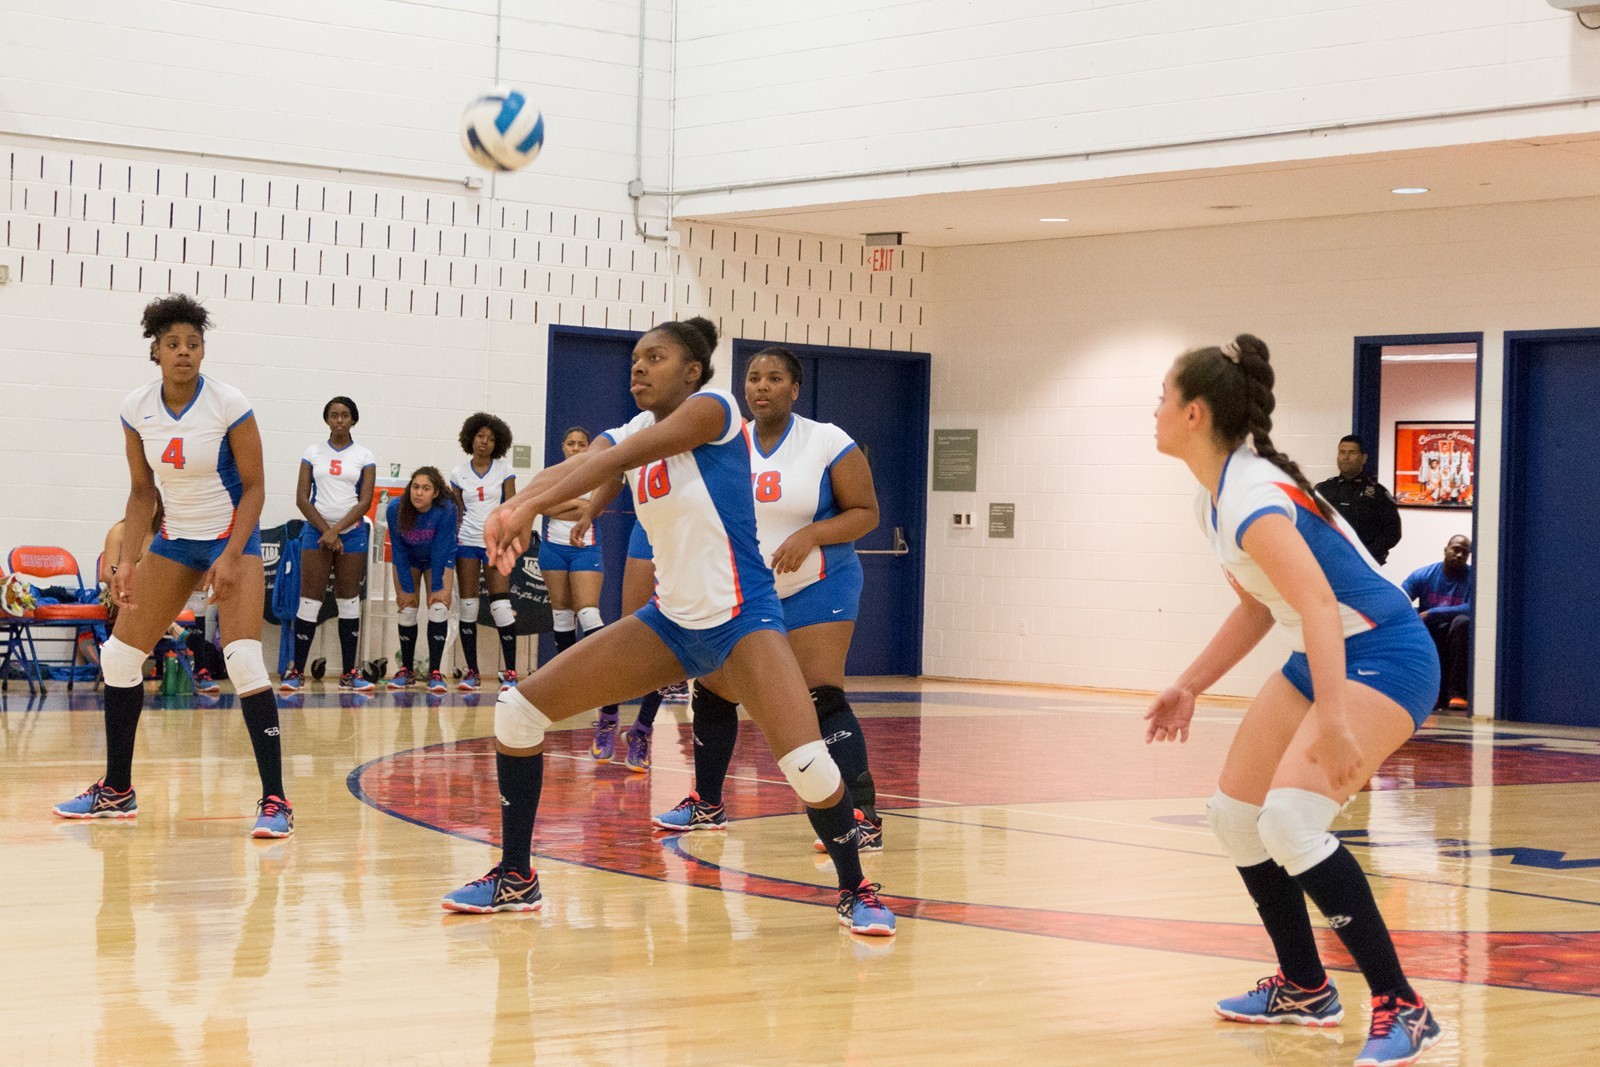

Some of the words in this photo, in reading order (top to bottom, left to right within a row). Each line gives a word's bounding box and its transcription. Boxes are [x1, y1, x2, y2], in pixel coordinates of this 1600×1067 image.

[873, 248, 894, 271] EXIT
[161, 437, 186, 469] 4
[329, 459, 342, 476] 5
[637, 459, 671, 504] 10
[476, 486, 484, 501] 1
